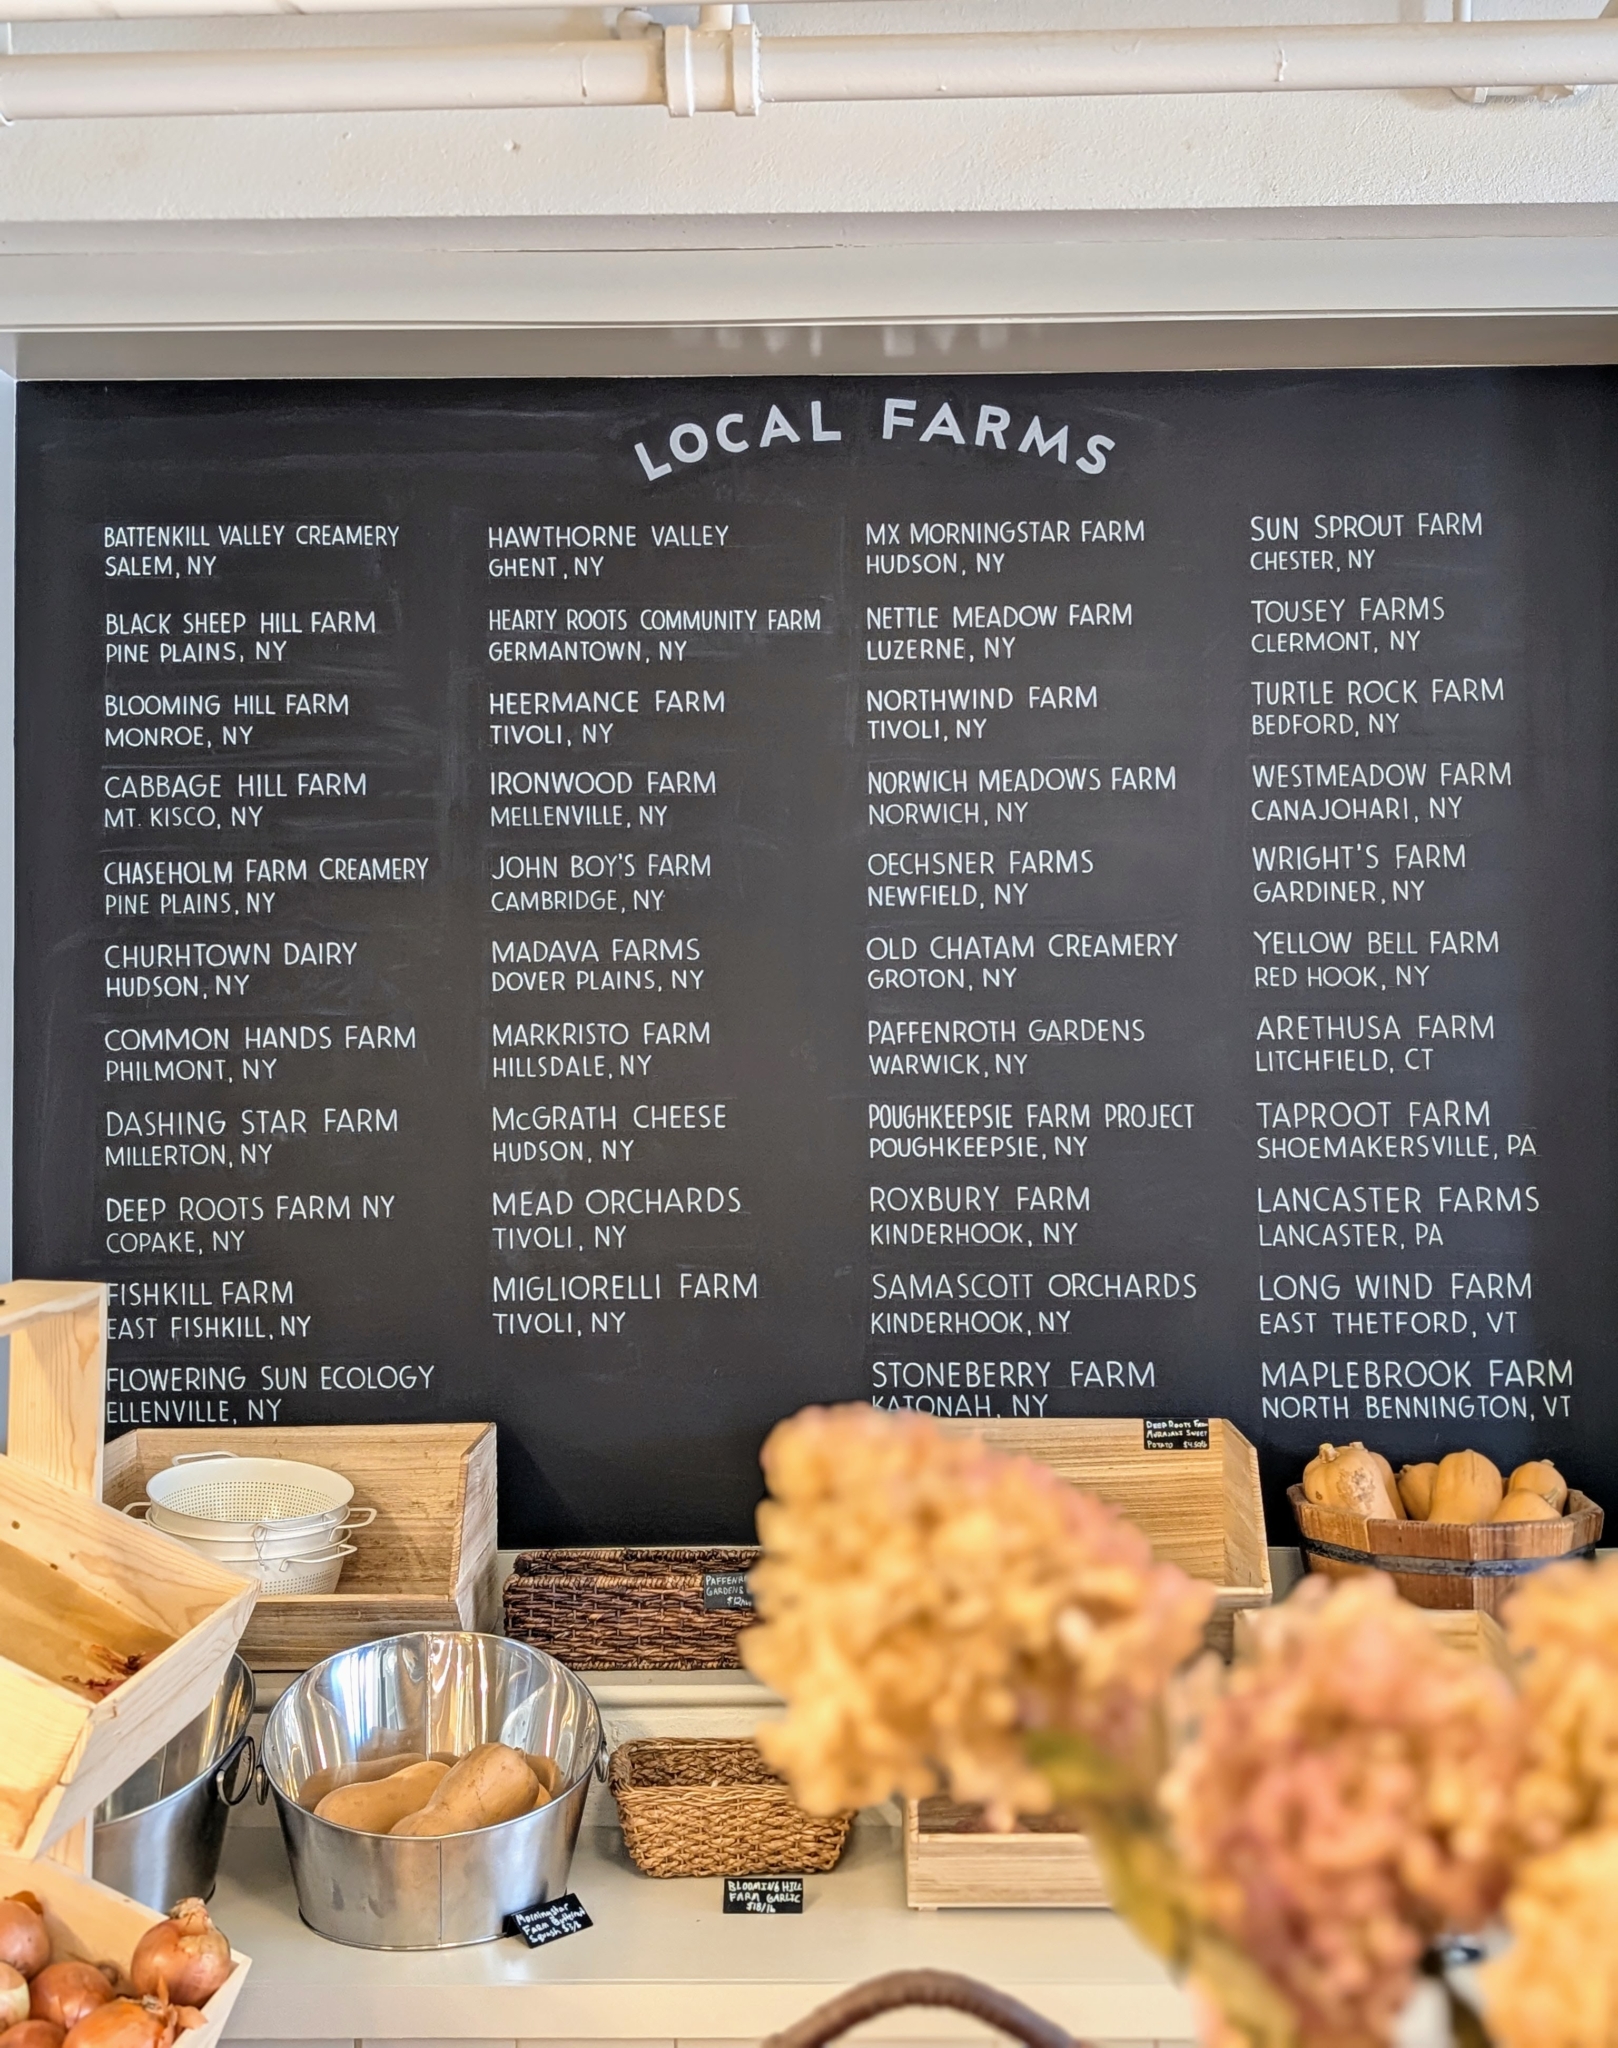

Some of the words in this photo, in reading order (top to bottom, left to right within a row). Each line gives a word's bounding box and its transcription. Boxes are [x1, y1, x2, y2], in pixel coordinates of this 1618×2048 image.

[634, 400, 842, 481] LOCAL
[882, 397, 1116, 475] FARMS
[104, 525, 211, 549] BATTENKILL
[217, 524, 286, 546] VALLEY
[295, 524, 400, 547] CREAMERY
[488, 524, 637, 549] HAWTHORNE
[650, 524, 729, 547] VALLEY
[865, 522, 901, 546] MX
[909, 519, 1071, 546] MORNINGSTAR
[1080, 519, 1145, 543] FARM
[1250, 515, 1299, 542] SUN
[1314, 513, 1405, 540] SPROUT
[1417, 511, 1483, 537] FARM
[104, 555, 181, 580] SALEM,
[187, 555, 217, 576] NY
[105, 612, 172, 636] BLACK
[182, 611, 247, 635] SHEEP
[260, 611, 303, 635] HILL
[310, 610, 376, 634] FARM
[488, 608, 558, 632] HEARTY
[566, 608, 628, 631] ROOTS
[639, 608, 758, 632] COMMUNITY
[767, 608, 821, 631] FARM
[866, 606, 939, 630] NETTLE
[952, 604, 1058, 629] MEADOW
[1068, 602, 1133, 627] FARM
[1250, 598, 1346, 624] TOUSEY
[1360, 596, 1445, 622] FARMS
[104, 694, 221, 717] BLOOMING
[234, 694, 277, 716] HILL
[285, 692, 349, 716] FARM
[489, 690, 639, 716] HEERMANCE
[655, 689, 725, 713] FARM
[866, 687, 1014, 713] NORTHWIND
[1028, 685, 1098, 710] FARM
[1250, 680, 1334, 706] TURTLE
[1347, 679, 1418, 705] ROCK
[1431, 677, 1505, 704] FARM
[104, 725, 212, 749] MONROE,
[222, 725, 254, 746] NY
[104, 773, 222, 799] CABBAGE
[238, 773, 288, 798] HILL
[297, 772, 367, 797] FARM
[490, 771, 633, 796] IRONWOOD
[647, 770, 716, 794] FARM
[867, 769, 968, 795] NORWICH
[978, 767, 1102, 793] MEADOWS
[1111, 765, 1176, 791] FARM
[1252, 763, 1427, 788] WESTMEADOW
[1440, 761, 1512, 787] FARM
[490, 804, 631, 829] MELLENVILLE,
[638, 805, 668, 827] NY
[491, 855, 558, 880] JOHN
[570, 852, 636, 879] BOY'S
[648, 853, 711, 877] FARM
[867, 850, 995, 876] OECHSNER
[1009, 849, 1094, 875] FARMS
[1251, 842, 1379, 872] WRIGHT'S
[1395, 843, 1466, 870] FARM
[103, 860, 233, 886] CHASEHOLM
[246, 858, 308, 883] FARM
[318, 857, 429, 881] CREAMERY
[1253, 879, 1386, 905] GARDINER,
[1392, 879, 1426, 902] NY
[104, 942, 271, 969] CHURHTOWN
[283, 941, 358, 966] DAIRY
[491, 939, 600, 964] MADAVA
[612, 937, 701, 962] FARMS
[865, 936, 918, 961] OLD
[929, 935, 1035, 961] CHATAM
[1048, 932, 1179, 958] CREAMERY
[1252, 930, 1353, 955] YELLOW
[1367, 930, 1419, 955] BELL
[1429, 930, 1499, 955] FARM
[104, 1027, 229, 1052] COMMON
[245, 1025, 332, 1050] HANDS
[345, 1024, 416, 1050] FARM
[492, 1022, 630, 1047] MARKRISTO
[643, 1021, 710, 1045] FARM
[867, 1019, 1016, 1046] PAFFENROTH
[1028, 1018, 1146, 1042] GARDENS
[1256, 1014, 1402, 1041] ARETHUSA
[1418, 1014, 1495, 1040] FARM
[868, 1053, 989, 1079] WARWICK,
[994, 1053, 1028, 1075] NY
[106, 1110, 227, 1137] DASHING
[241, 1108, 307, 1135] STAR
[324, 1107, 398, 1133] FARM
[492, 1105, 617, 1132] McGRATH
[633, 1103, 726, 1130] CHEESE
[868, 1103, 1014, 1130] POUGHKEEPSIE
[1026, 1102, 1091, 1129] FARM
[1104, 1102, 1195, 1130] PROJECT
[1255, 1101, 1392, 1129] TAPROOT
[1409, 1099, 1490, 1128] FARM
[493, 1140, 592, 1164] HUDSON,
[602, 1139, 635, 1162] NY
[1256, 1134, 1498, 1161] SHOEMAKERSVILLE,
[1507, 1133, 1537, 1157] PA
[106, 1197, 167, 1223] DEEP
[179, 1196, 264, 1222] ROOTS
[276, 1194, 351, 1221] FARM
[362, 1194, 395, 1219] NY
[492, 1190, 574, 1217] MEAD
[585, 1186, 742, 1215] ORCHARDS
[869, 1185, 1000, 1213] ROXBURY
[1016, 1185, 1090, 1212] FARM
[1257, 1186, 1422, 1214] LANCASTER
[1438, 1185, 1540, 1213] FARMS
[106, 1282, 213, 1307] FISHKILL
[222, 1279, 293, 1305] FARM
[493, 1273, 661, 1303] MIGLIORELLI
[680, 1272, 758, 1299] FARM
[872, 1272, 1034, 1301] SAMASCOTT
[1047, 1272, 1197, 1299] ORCHARDS
[1259, 1273, 1341, 1302] LONG
[1354, 1272, 1433, 1300] WIND
[1451, 1272, 1532, 1300] FARM
[107, 1316, 158, 1340] EAST
[170, 1315, 274, 1341] FISHKILL,
[280, 1315, 312, 1338] NY
[1259, 1311, 1318, 1335] EAST
[1331, 1310, 1477, 1339] THETFORD,
[1486, 1310, 1518, 1334] VT
[107, 1365, 247, 1393] FLOWERING
[260, 1365, 307, 1391] SUN
[320, 1364, 435, 1391] ECOLOGY
[872, 1360, 1051, 1389] STONEBERRY
[1070, 1360, 1156, 1388] FARM
[1261, 1359, 1472, 1390] MAPLEBROOK
[1488, 1358, 1573, 1388] FARM
[1012, 1393, 1049, 1418] NY
